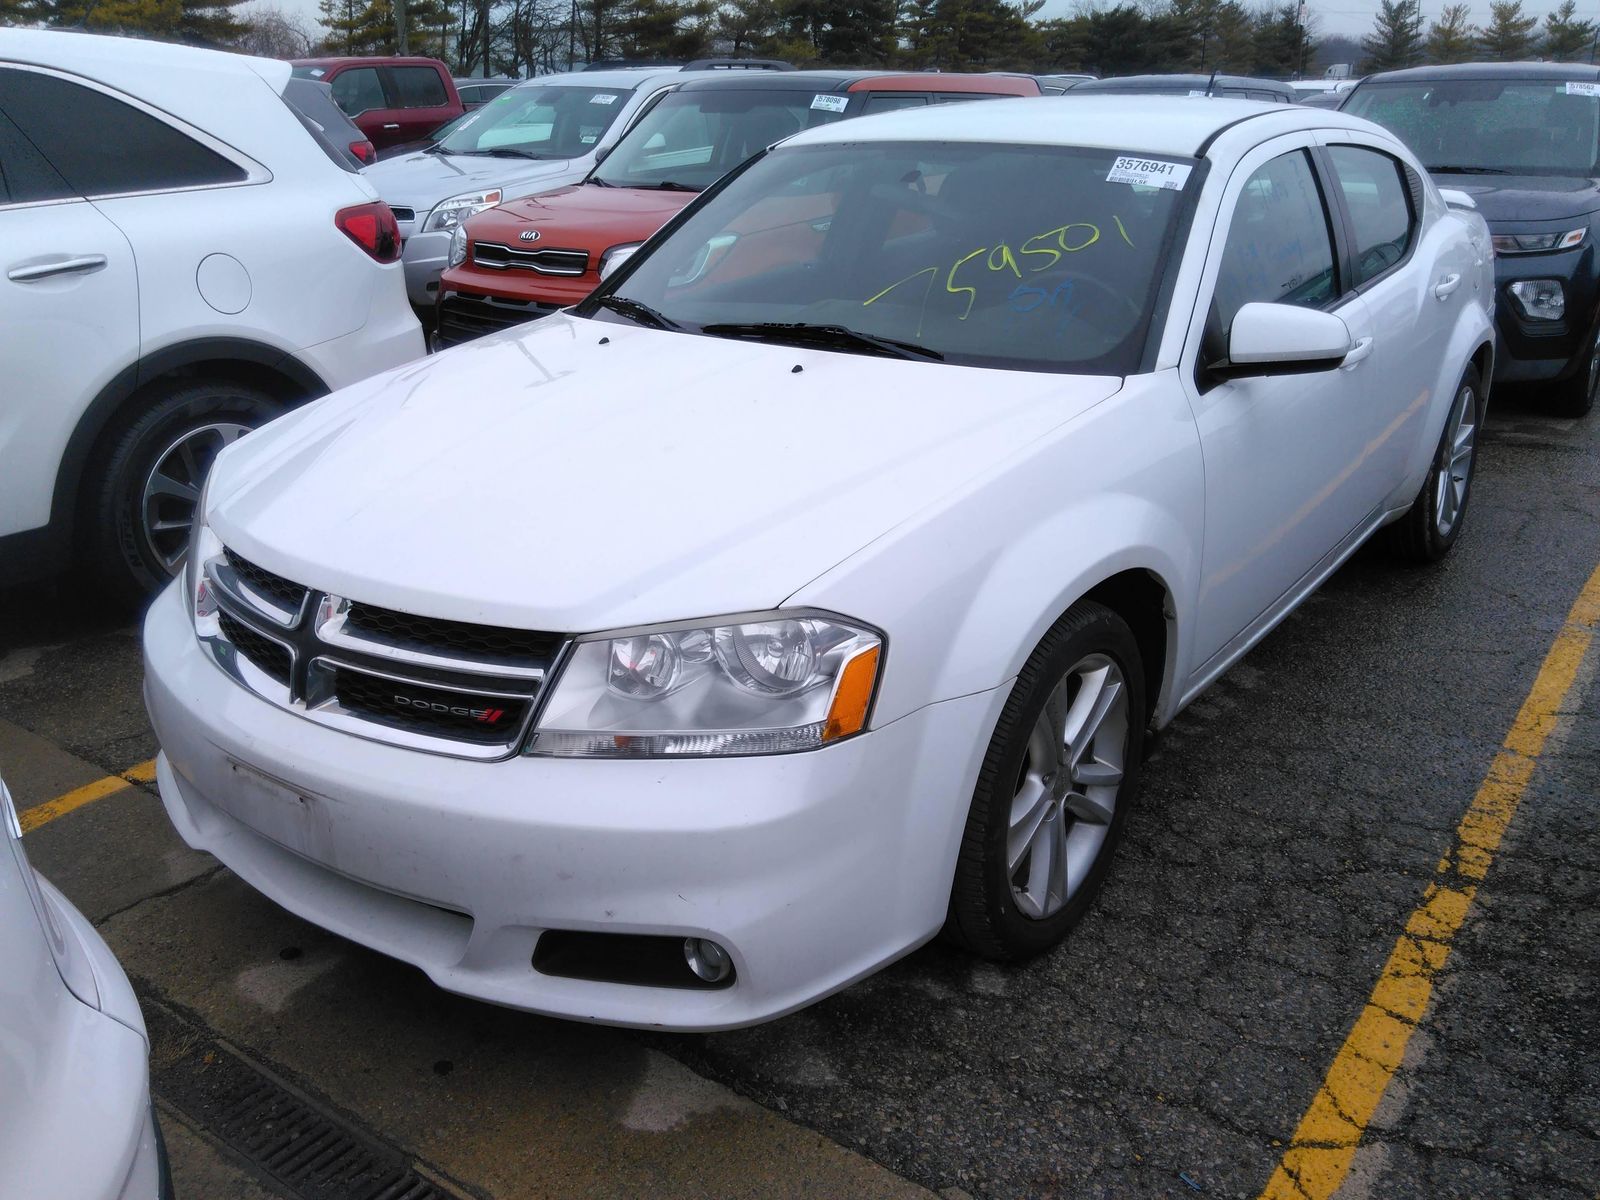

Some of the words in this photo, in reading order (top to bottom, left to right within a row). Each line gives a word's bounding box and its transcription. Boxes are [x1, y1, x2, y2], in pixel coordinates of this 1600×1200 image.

[1116, 158, 1176, 175] 3576941
[520, 231, 537, 240] KIA
[395, 695, 488, 719] DODGE
